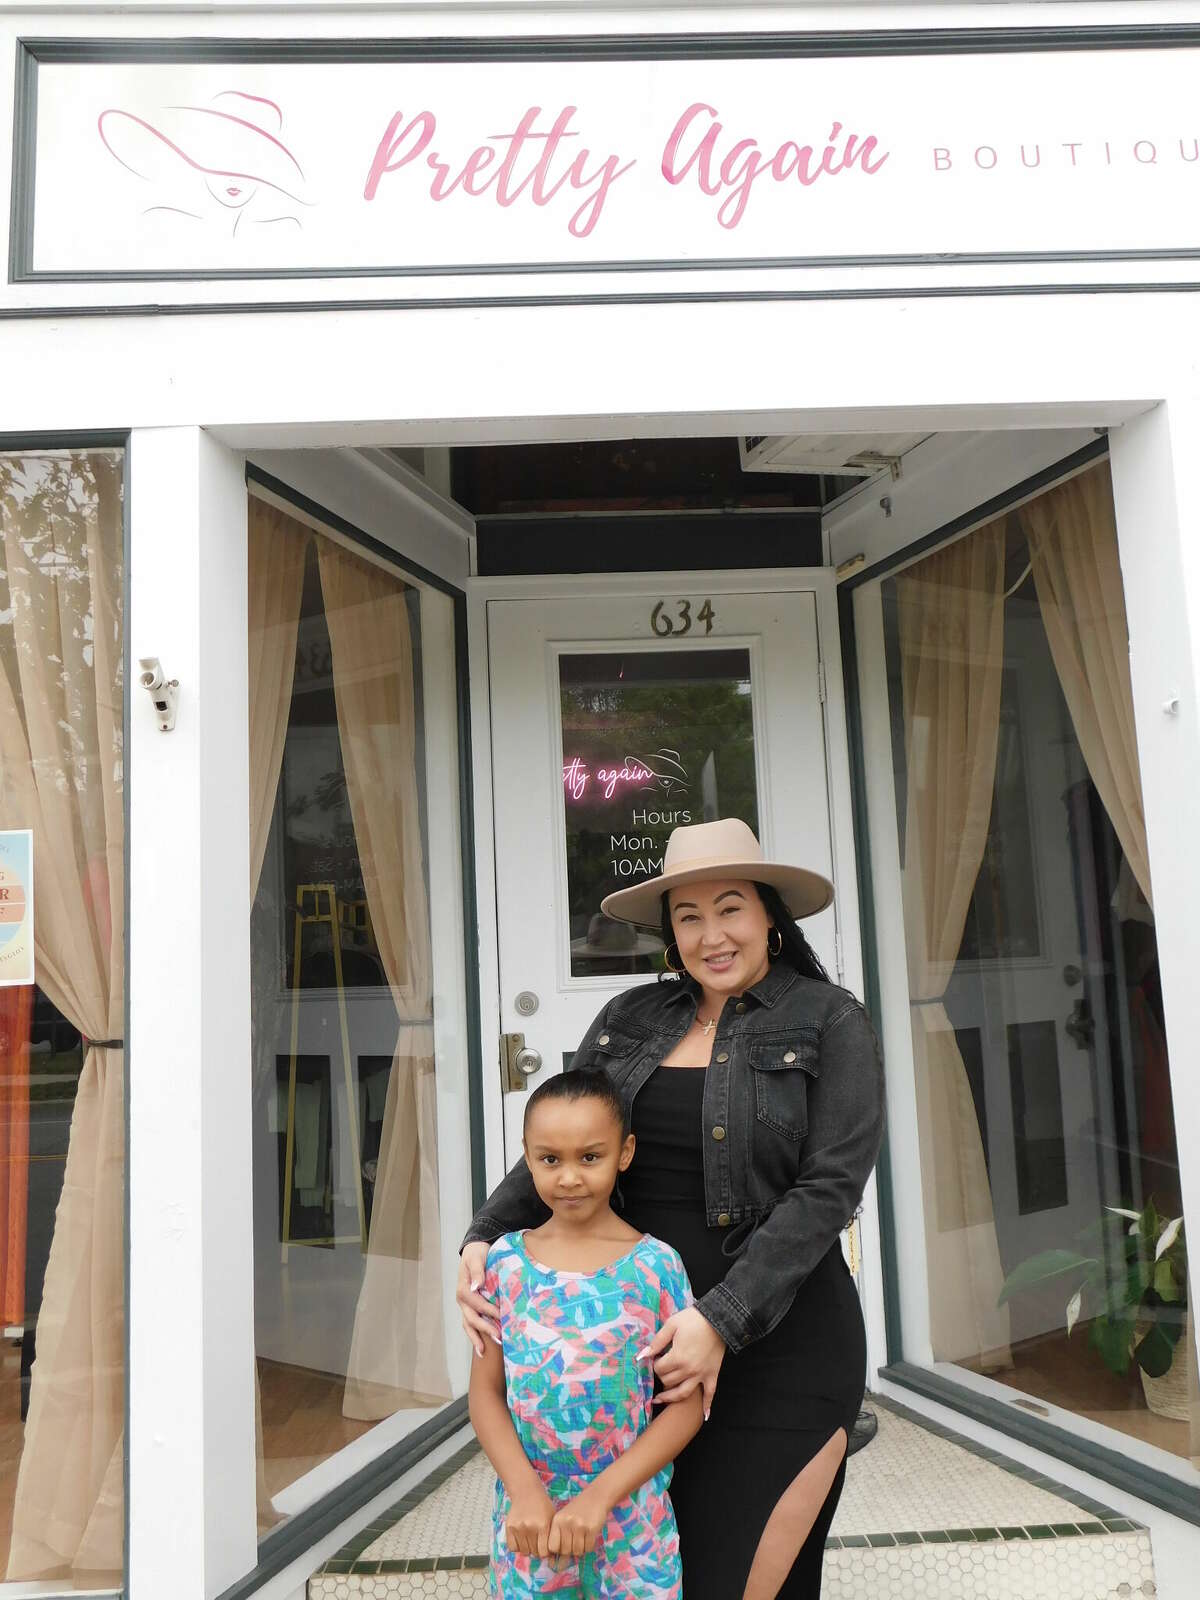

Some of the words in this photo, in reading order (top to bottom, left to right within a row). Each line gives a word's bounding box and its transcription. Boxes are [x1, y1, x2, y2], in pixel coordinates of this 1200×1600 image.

[363, 105, 637, 238] Pretty
[661, 102, 889, 230] Again
[650, 599, 716, 637] 634
[597, 765, 655, 799] again
[632, 808, 692, 825] Hours
[610, 834, 658, 851] Mon.
